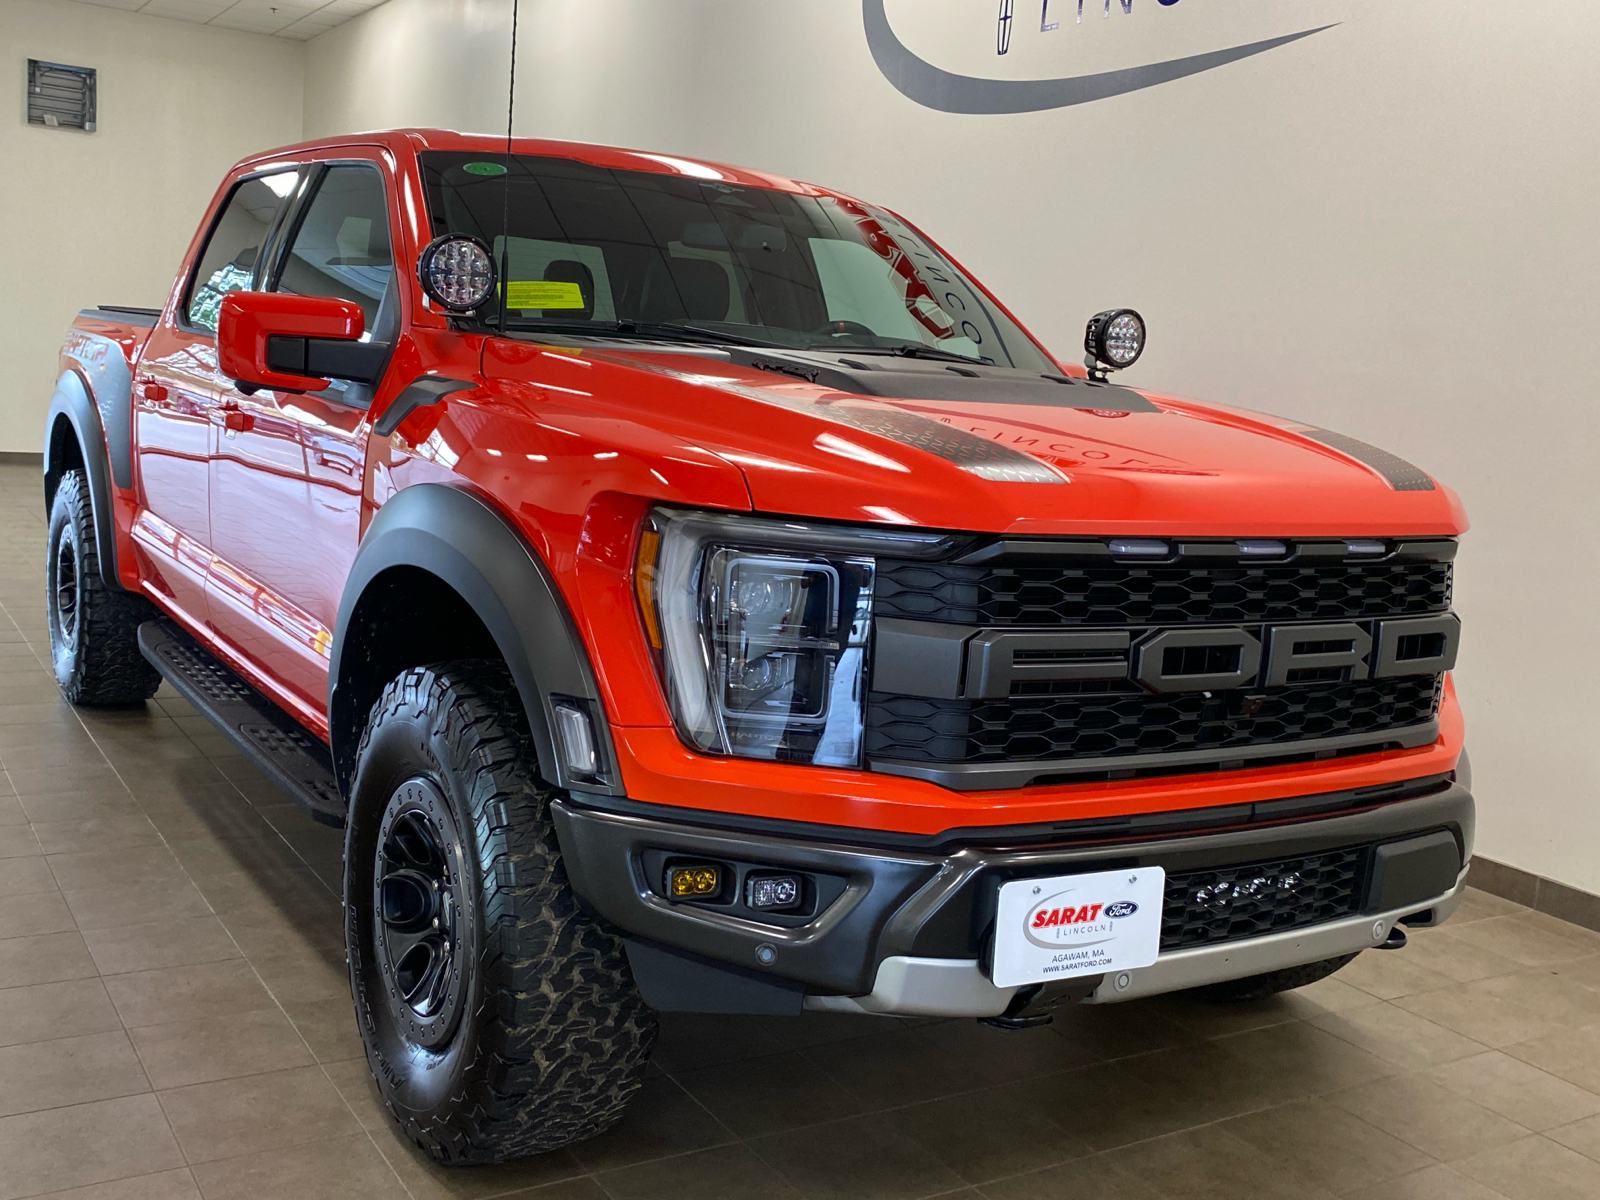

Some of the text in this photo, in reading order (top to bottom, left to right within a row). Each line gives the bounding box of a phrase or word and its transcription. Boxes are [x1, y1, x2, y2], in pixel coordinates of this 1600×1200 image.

[966, 613, 1461, 699] FORD
[1031, 902, 1134, 929] SARAT Ford
[1063, 924, 1106, 936] LINCOLN
[1052, 949, 1105, 963] AGAWAM, MA
[1043, 958, 1112, 973] WWW.SARATFORD.COM
